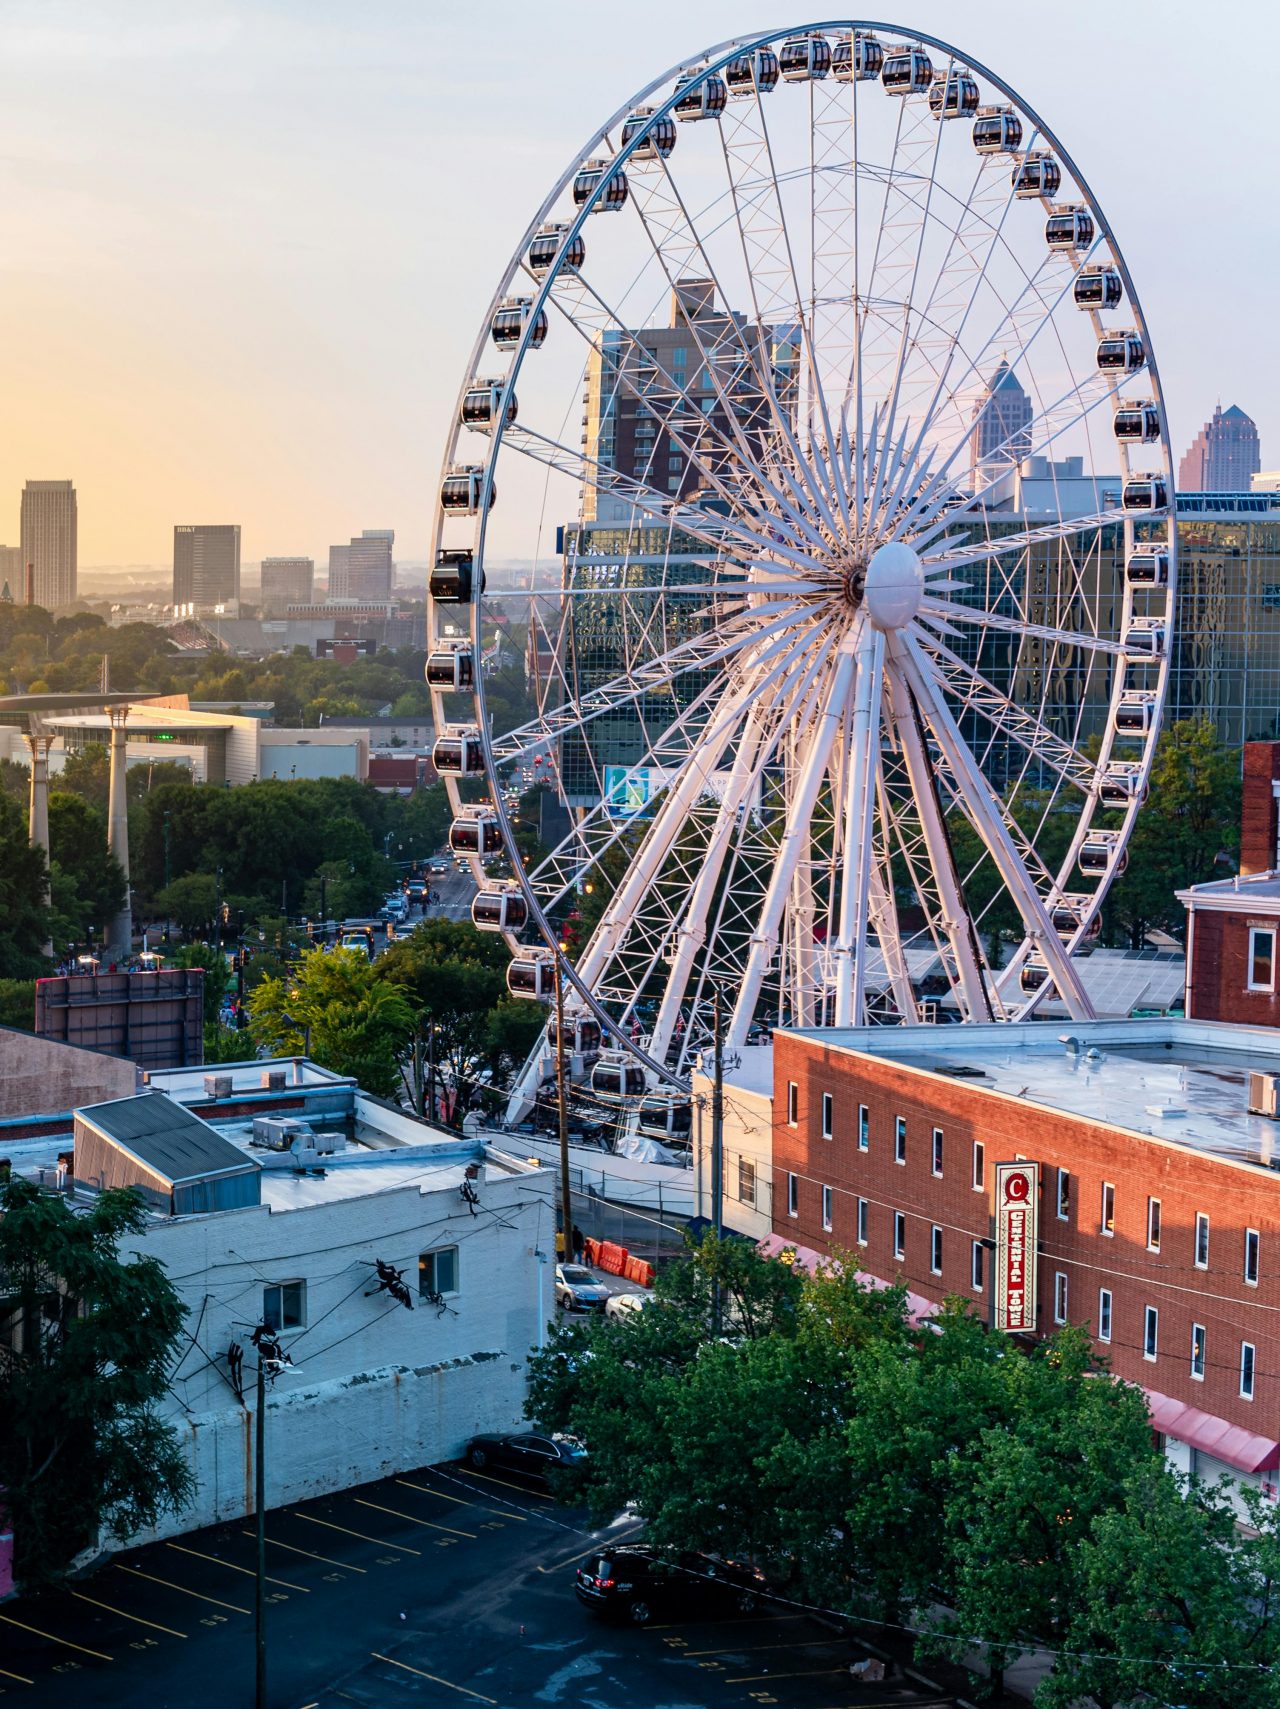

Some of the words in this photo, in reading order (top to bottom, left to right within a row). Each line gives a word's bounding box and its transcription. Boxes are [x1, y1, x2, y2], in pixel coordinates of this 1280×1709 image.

[1009, 1179, 1023, 1197] C
[1010, 1211, 1024, 1283] CENTENNIAL
[1008, 1289, 1024, 1326] TOWNE
[747, 1691, 780, 1704] 20
